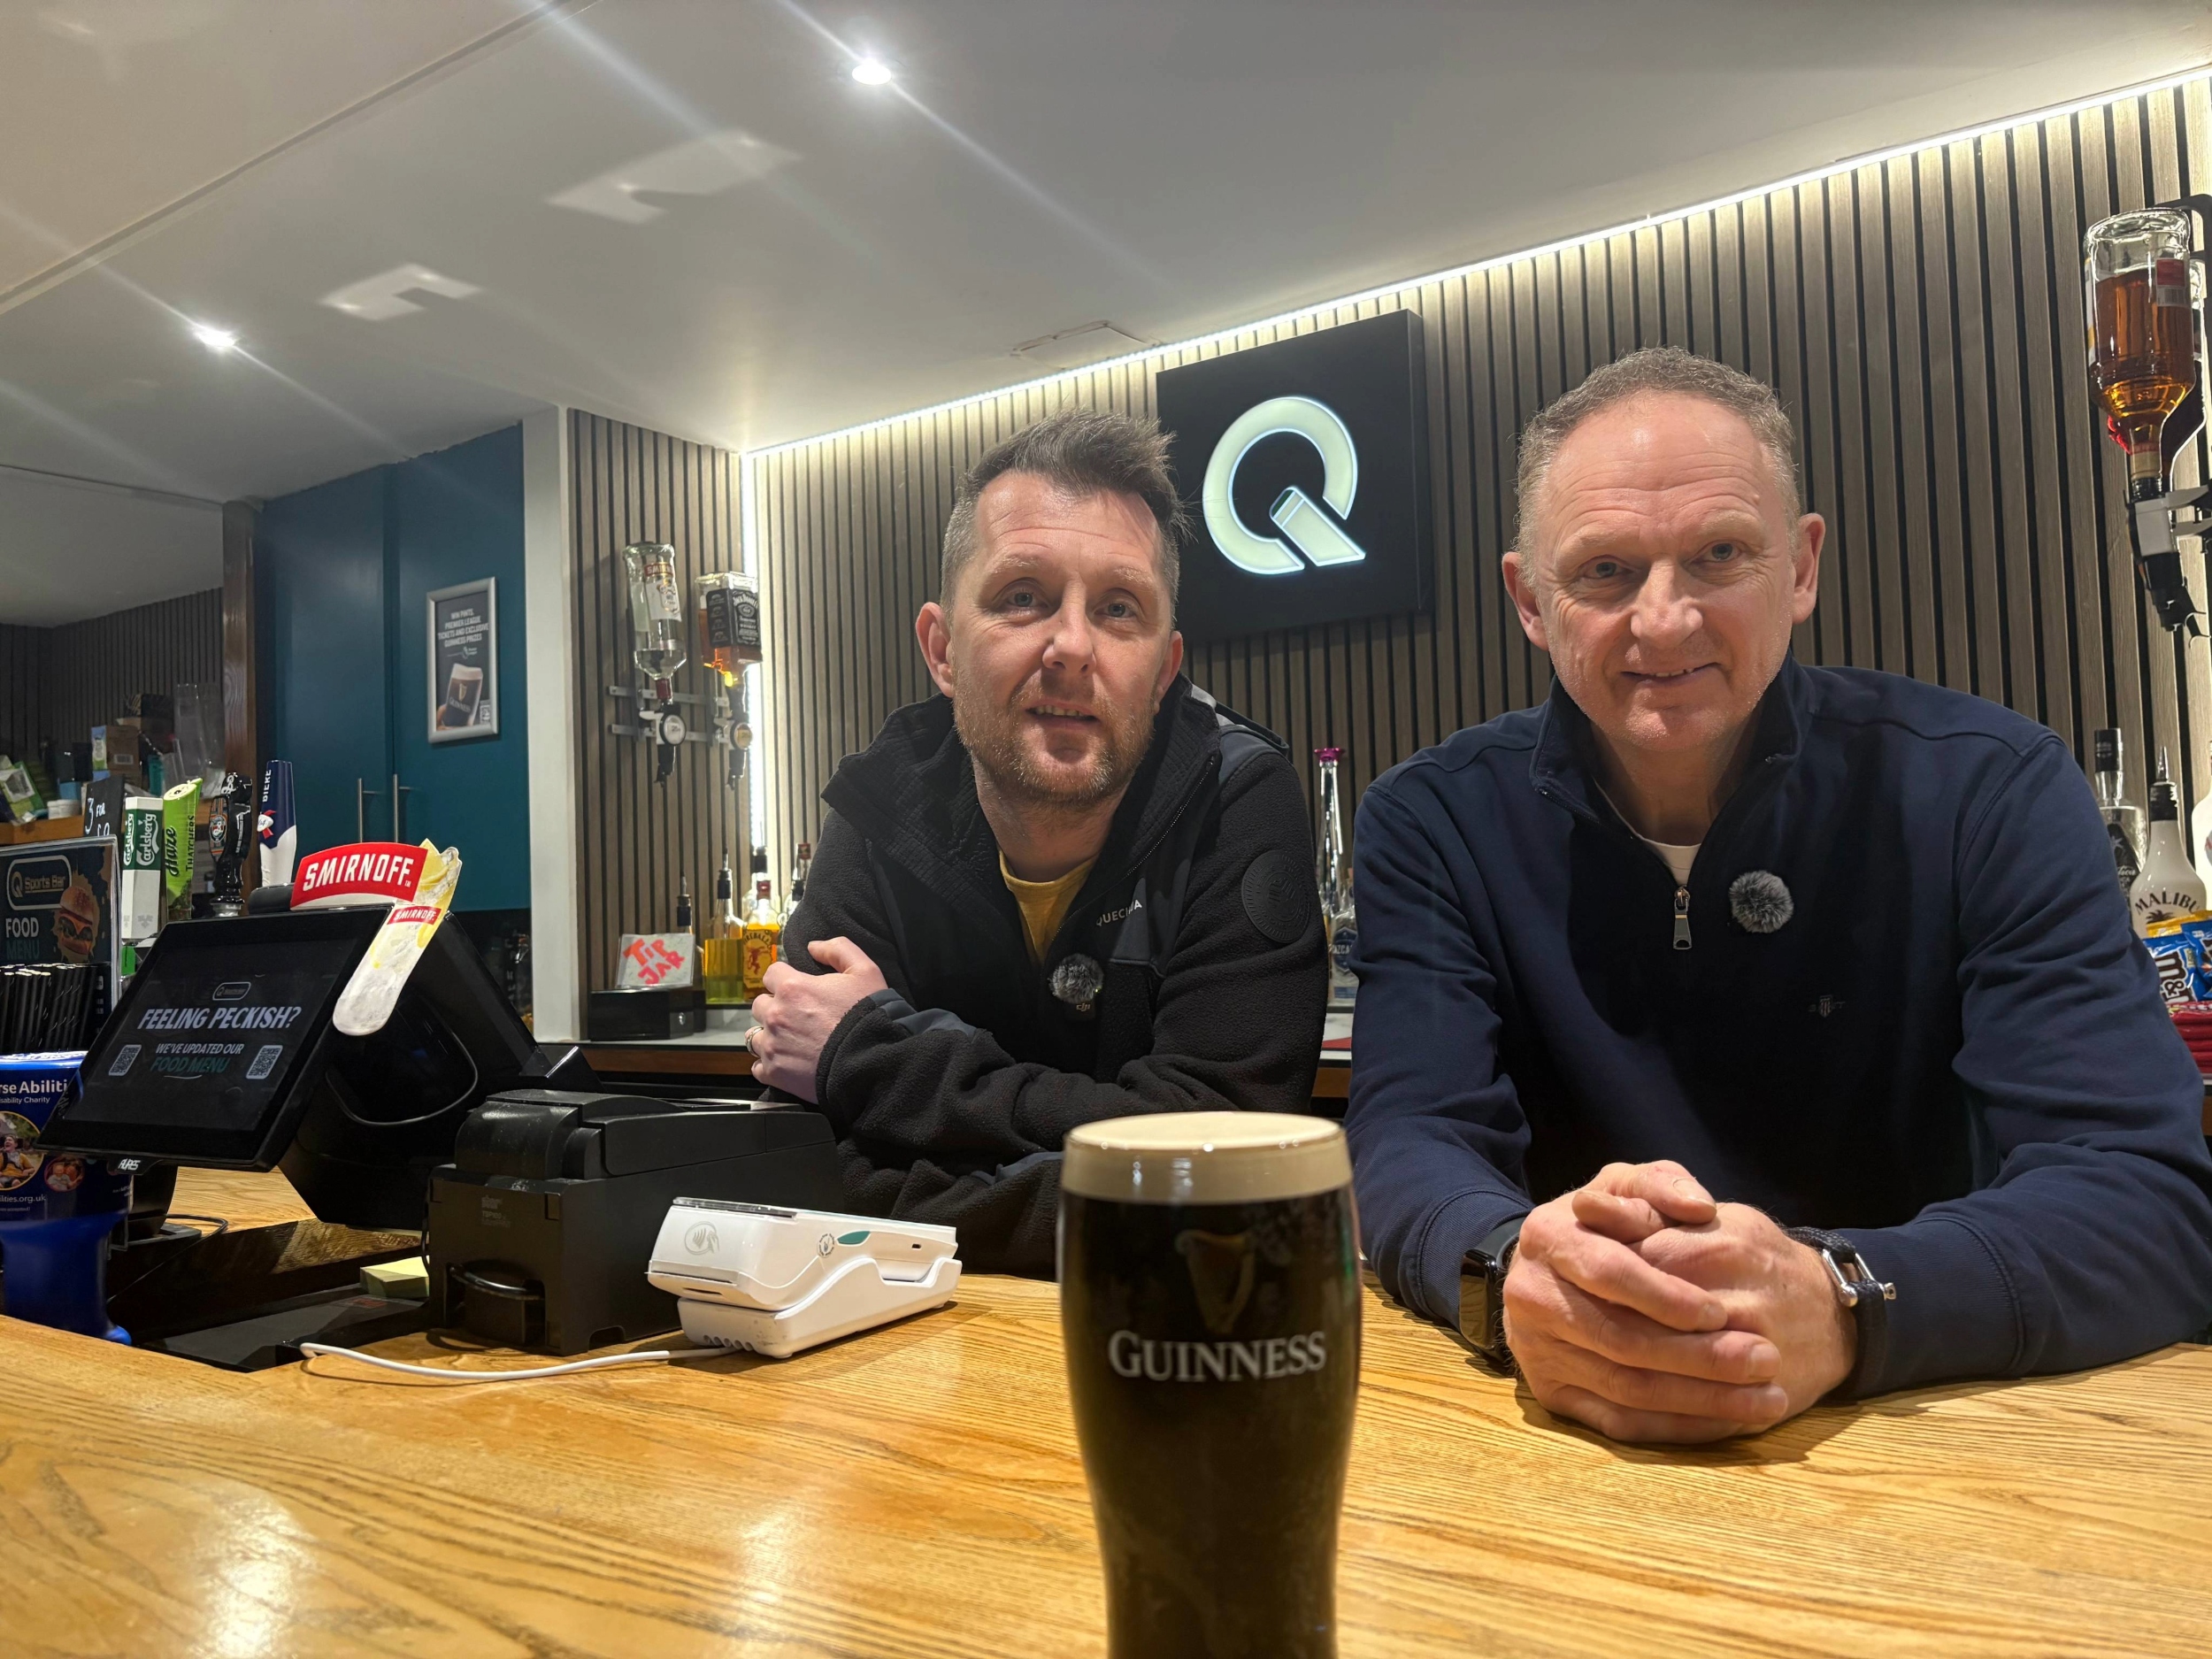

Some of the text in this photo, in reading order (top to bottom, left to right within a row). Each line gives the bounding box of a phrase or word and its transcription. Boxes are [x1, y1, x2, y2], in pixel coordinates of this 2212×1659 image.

[1202, 396, 1366, 575] Q
[445, 615, 480, 629] PREMIER LEAGUE
[438, 629, 455, 640] TICKETS
[444, 635, 466, 648] GUINNESS
[124, 813, 134, 866] Carlsberg
[136, 813, 157, 866] Carlsberg
[185, 814, 196, 872] THATCHERS
[165, 825, 180, 877] Haze
[25, 875, 50, 891] Sports
[51, 874, 65, 888] Bar
[303, 853, 414, 892] SMIRNOFF
[394, 907, 436, 921] SMIRNOFF
[5, 917, 39, 938] FOOD
[6, 939, 40, 960] MENU
[137, 1006, 302, 1029] FEELING PECKISH?
[155, 1043, 244, 1055] WE'VE UPDATED OUR
[150, 1056, 228, 1073] FOOD MENU
[1108, 1329, 1327, 1382] GUINNESS
